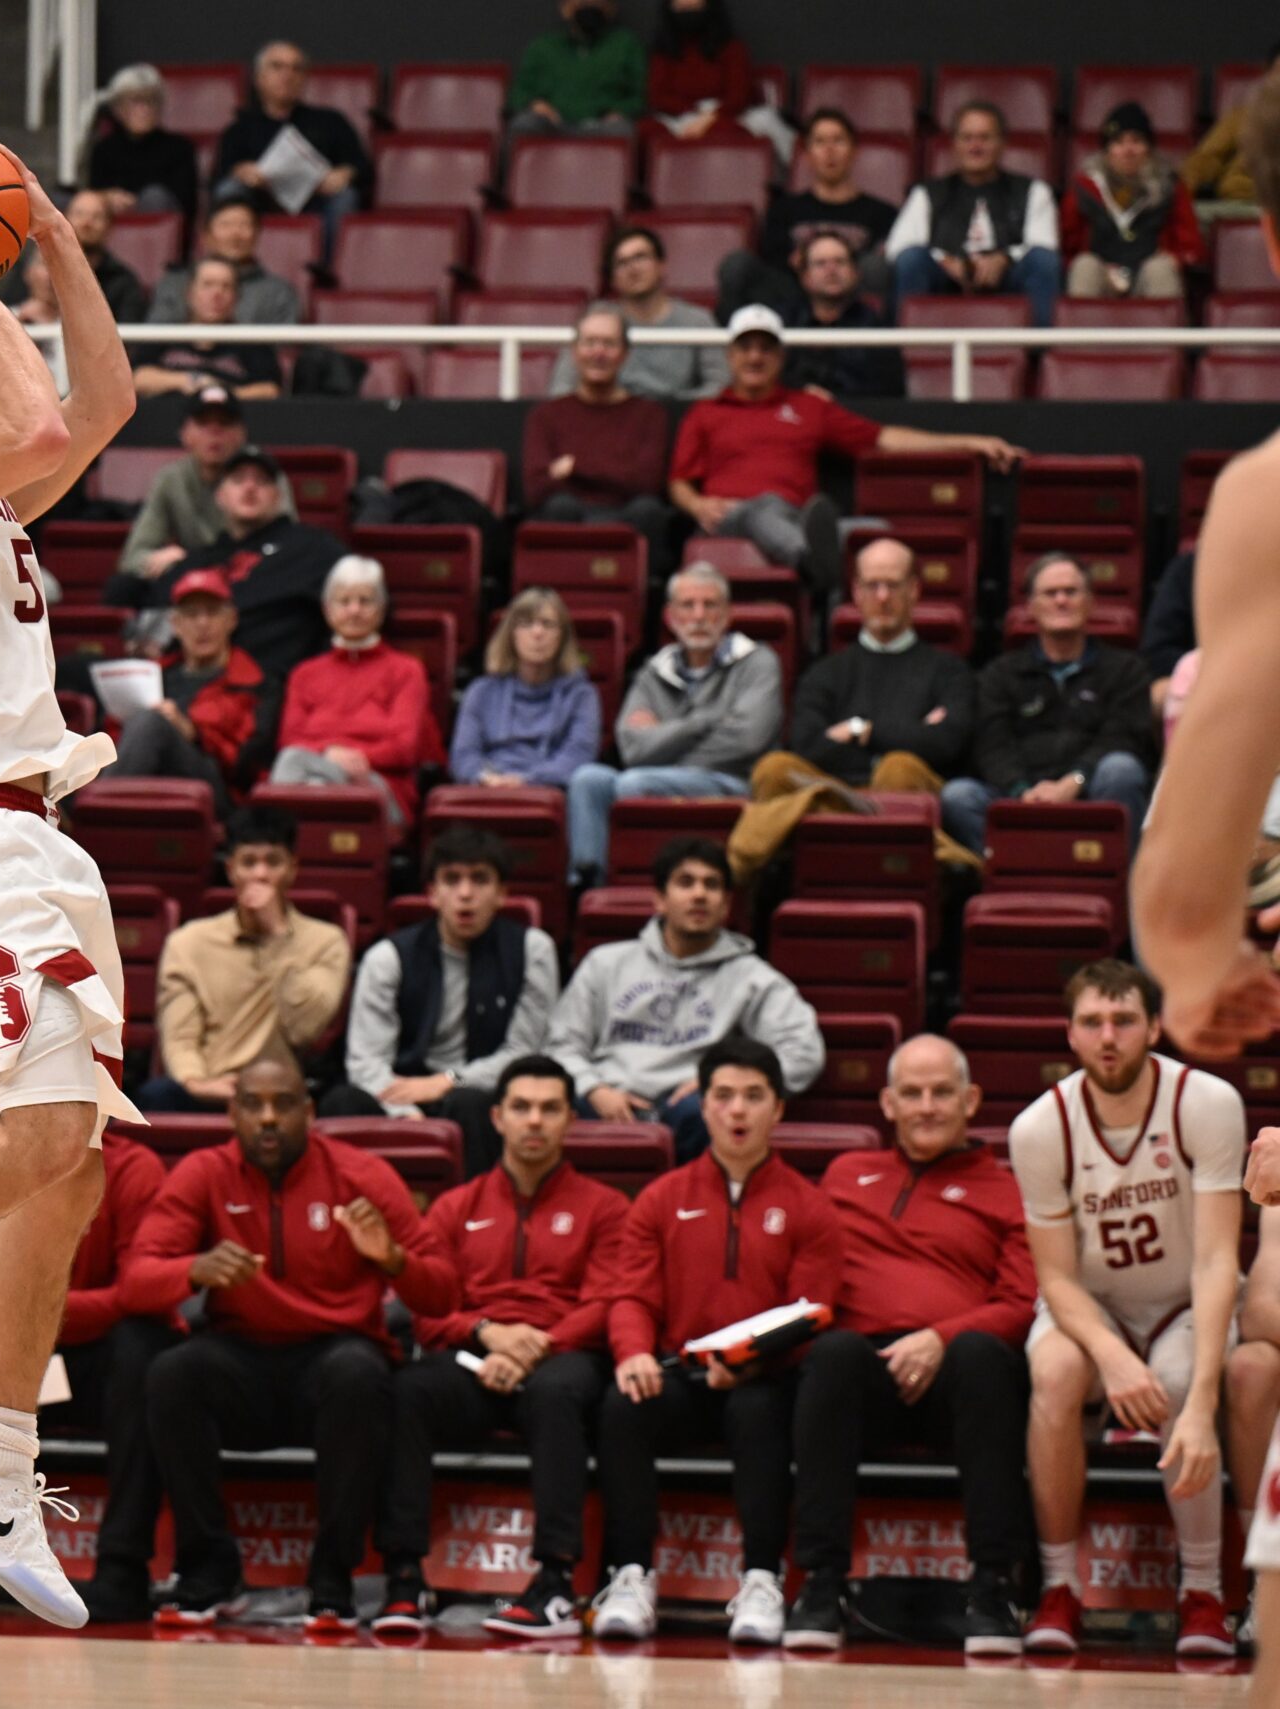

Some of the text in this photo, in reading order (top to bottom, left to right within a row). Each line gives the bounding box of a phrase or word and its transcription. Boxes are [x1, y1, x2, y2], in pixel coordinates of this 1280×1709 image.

[10, 538, 45, 624] 5
[1100, 1213, 1164, 1270] 52
[232, 1502, 318, 1529] WEL
[448, 1503, 534, 1536] WEL
[659, 1510, 743, 1544] WEL
[236, 1536, 317, 1567] FAR
[1089, 1521, 1177, 1551] WEL
[866, 1554, 975, 1582] FARG
